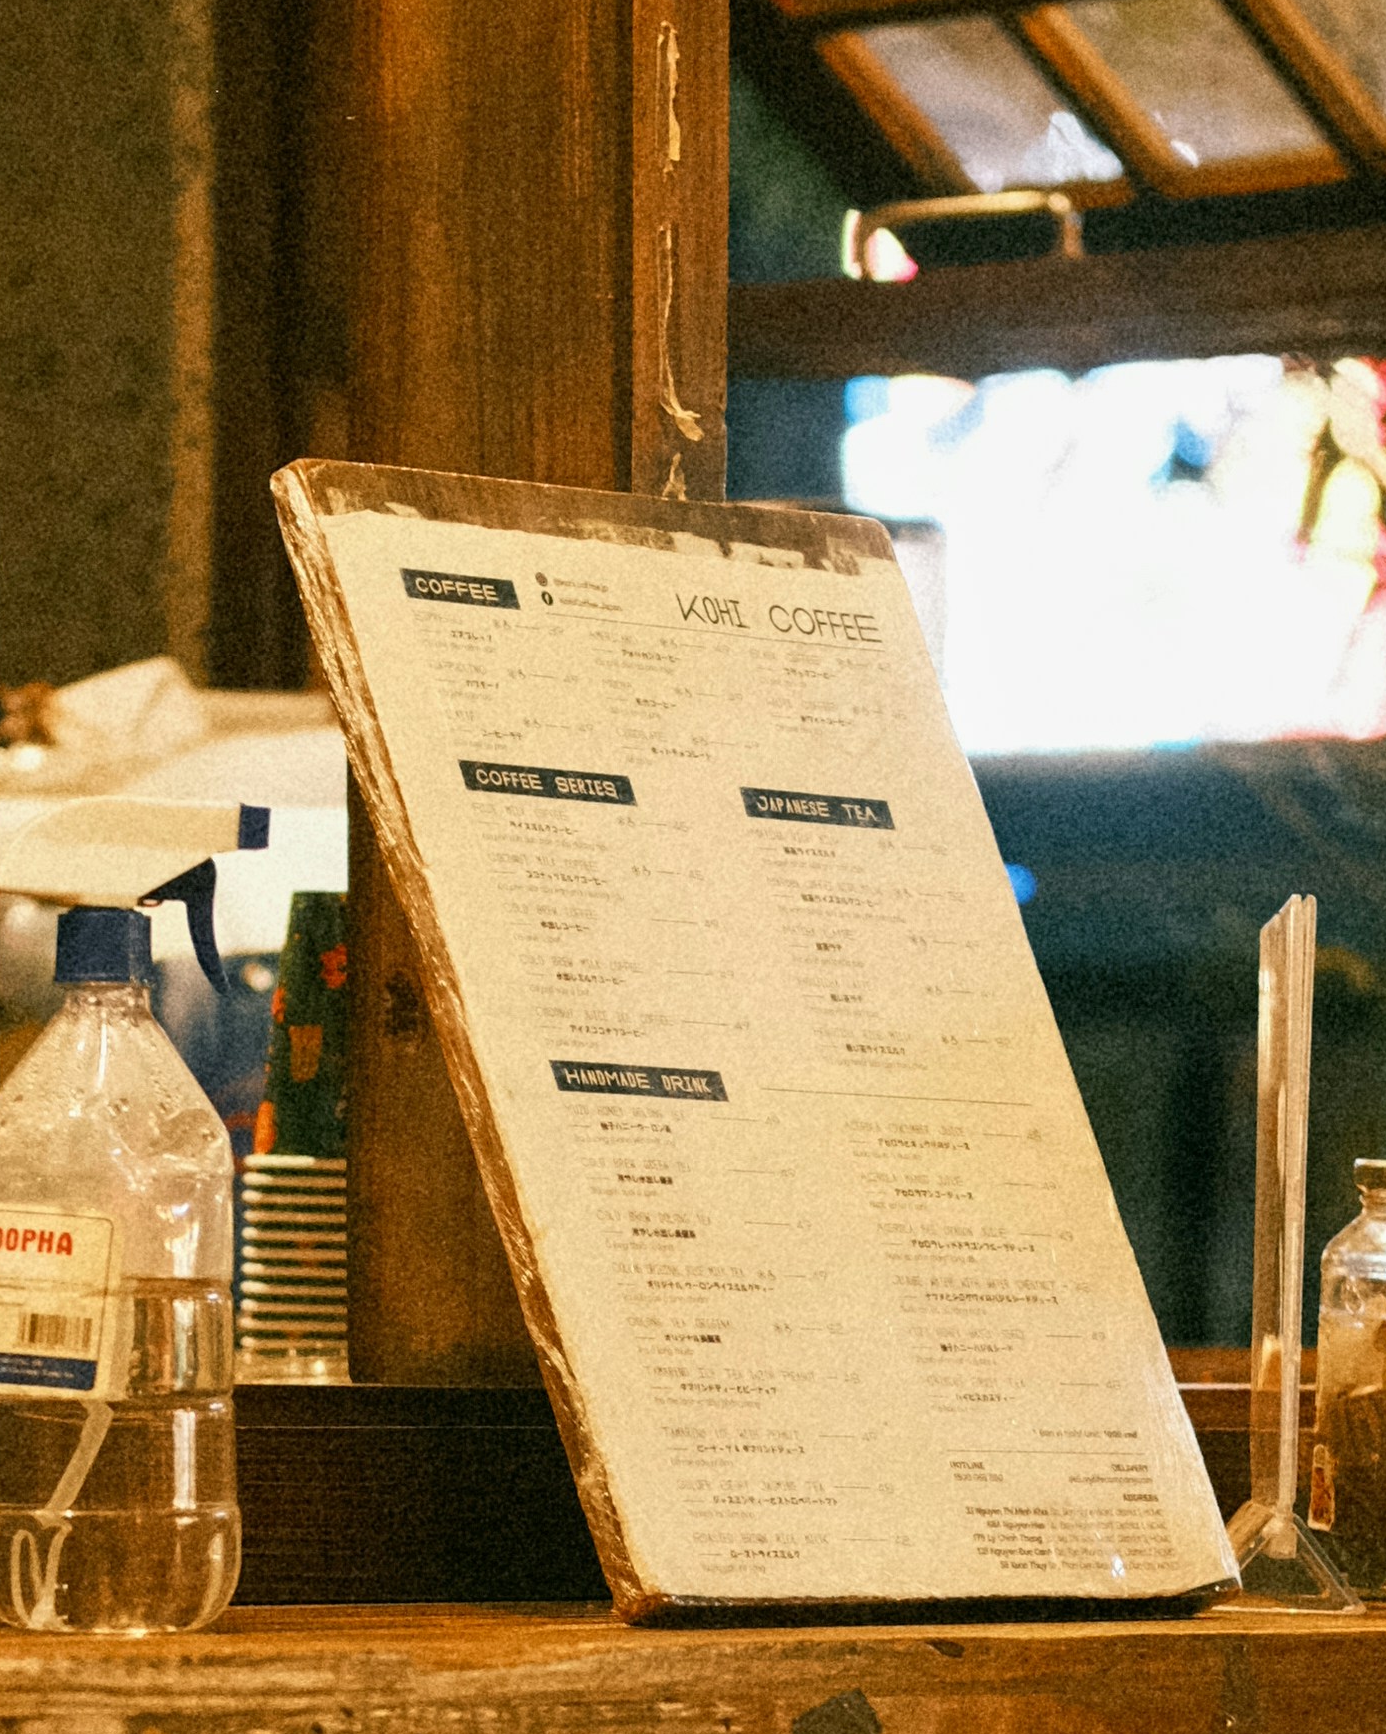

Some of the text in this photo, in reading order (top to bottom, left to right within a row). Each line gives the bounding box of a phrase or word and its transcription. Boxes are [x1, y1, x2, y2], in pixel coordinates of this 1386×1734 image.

[415, 577, 501, 601] COFFEE
[675, 593, 884, 644] KOHI COFFEE
[474, 768, 620, 800] COFFEE SERIES
[755, 795, 879, 822] JAPANESE TEA
[565, 1068, 712, 1094] HANDMADE DRINK
